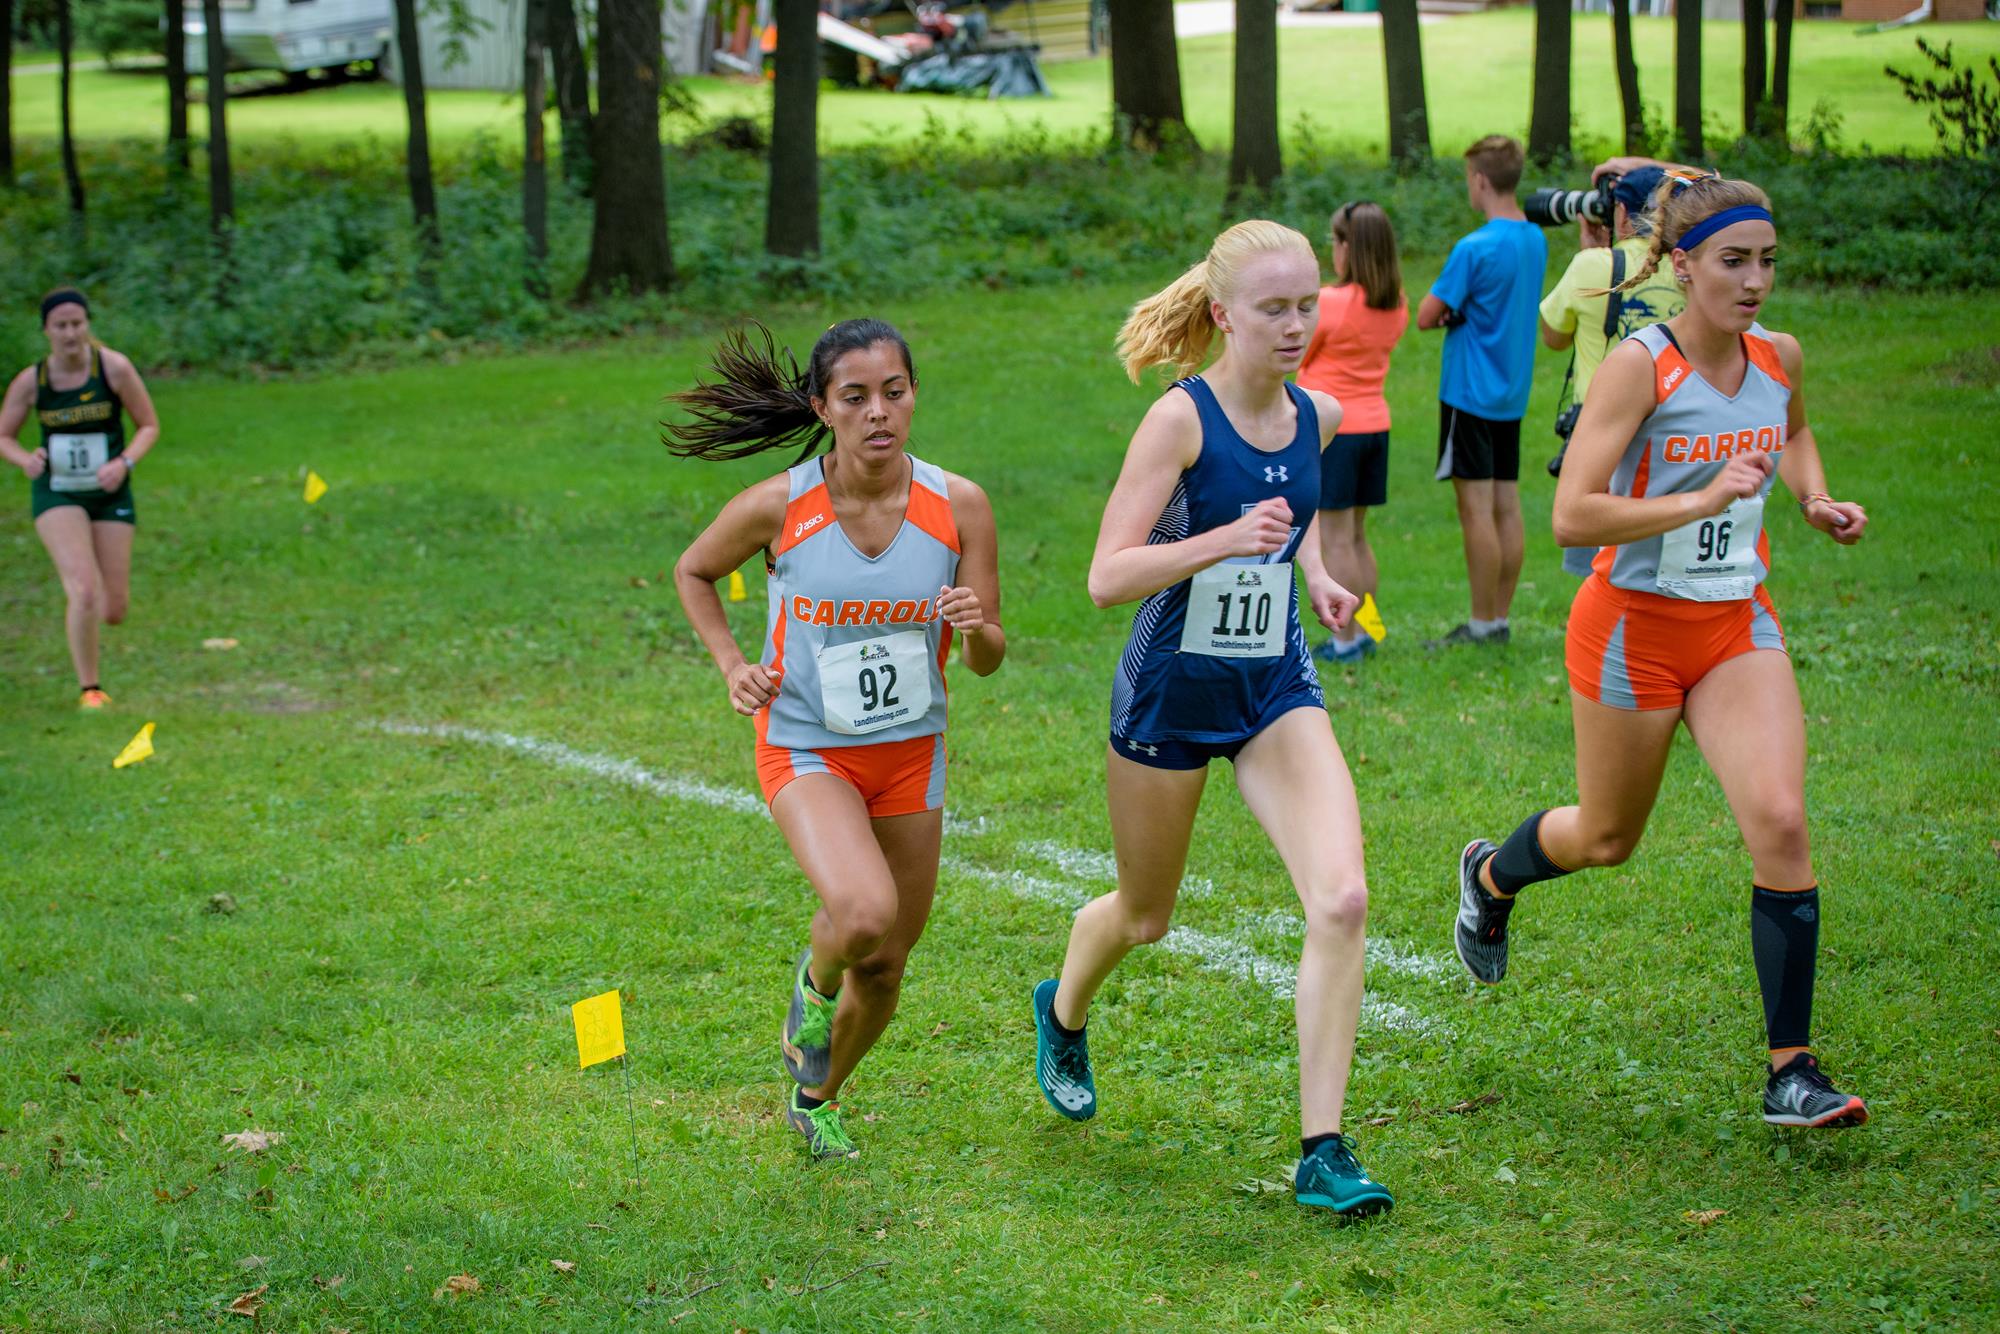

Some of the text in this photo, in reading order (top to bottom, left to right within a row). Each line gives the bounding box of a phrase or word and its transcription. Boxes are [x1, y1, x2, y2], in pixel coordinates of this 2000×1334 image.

[67, 449, 91, 470] 10
[1664, 422, 1789, 464] CARROL
[1697, 520, 1734, 561] 96
[1212, 592, 1271, 636] 110
[1211, 640, 1266, 651] tandhtiming.com
[858, 664, 899, 711] 92
[853, 707, 909, 727] tandhtiming.com
